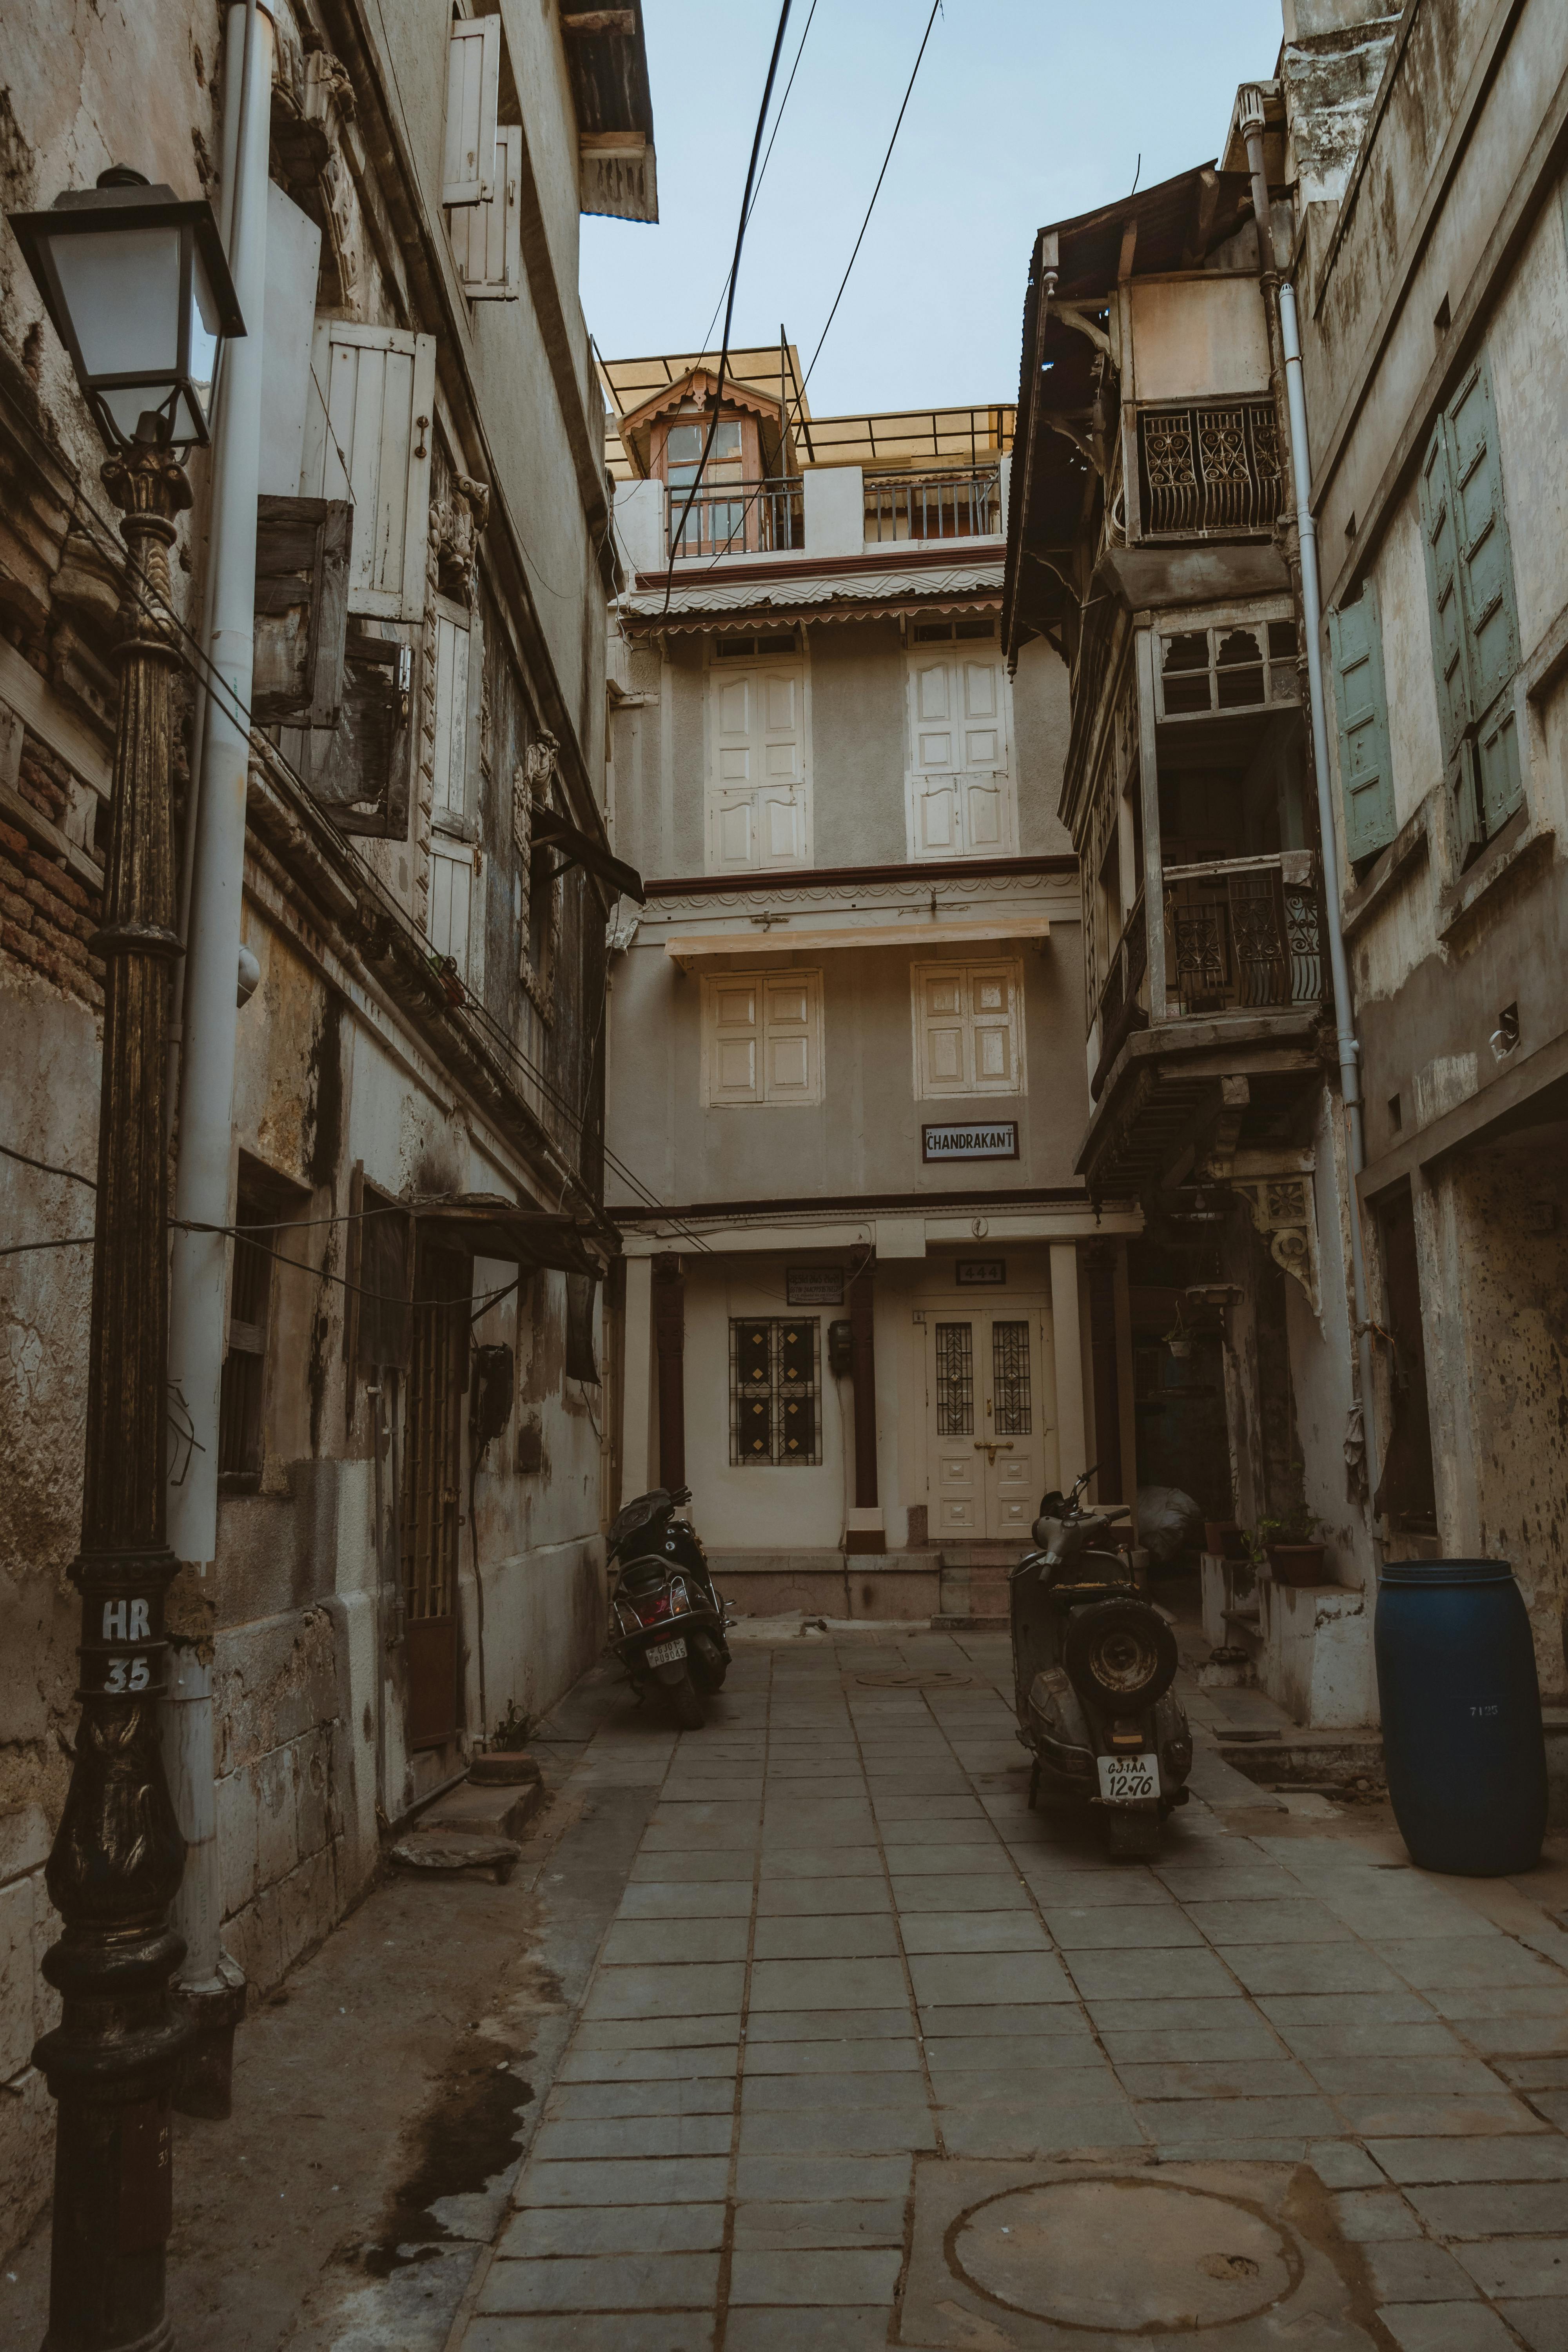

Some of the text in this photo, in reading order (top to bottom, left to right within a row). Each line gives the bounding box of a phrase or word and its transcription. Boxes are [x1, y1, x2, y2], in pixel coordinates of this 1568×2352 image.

[965, 1266, 998, 1279] 444
[102, 1598, 151, 1641] HR
[658, 1641, 677, 1654] GJ01
[655, 1648, 685, 1665] PU9045
[104, 1656, 150, 1692] 35
